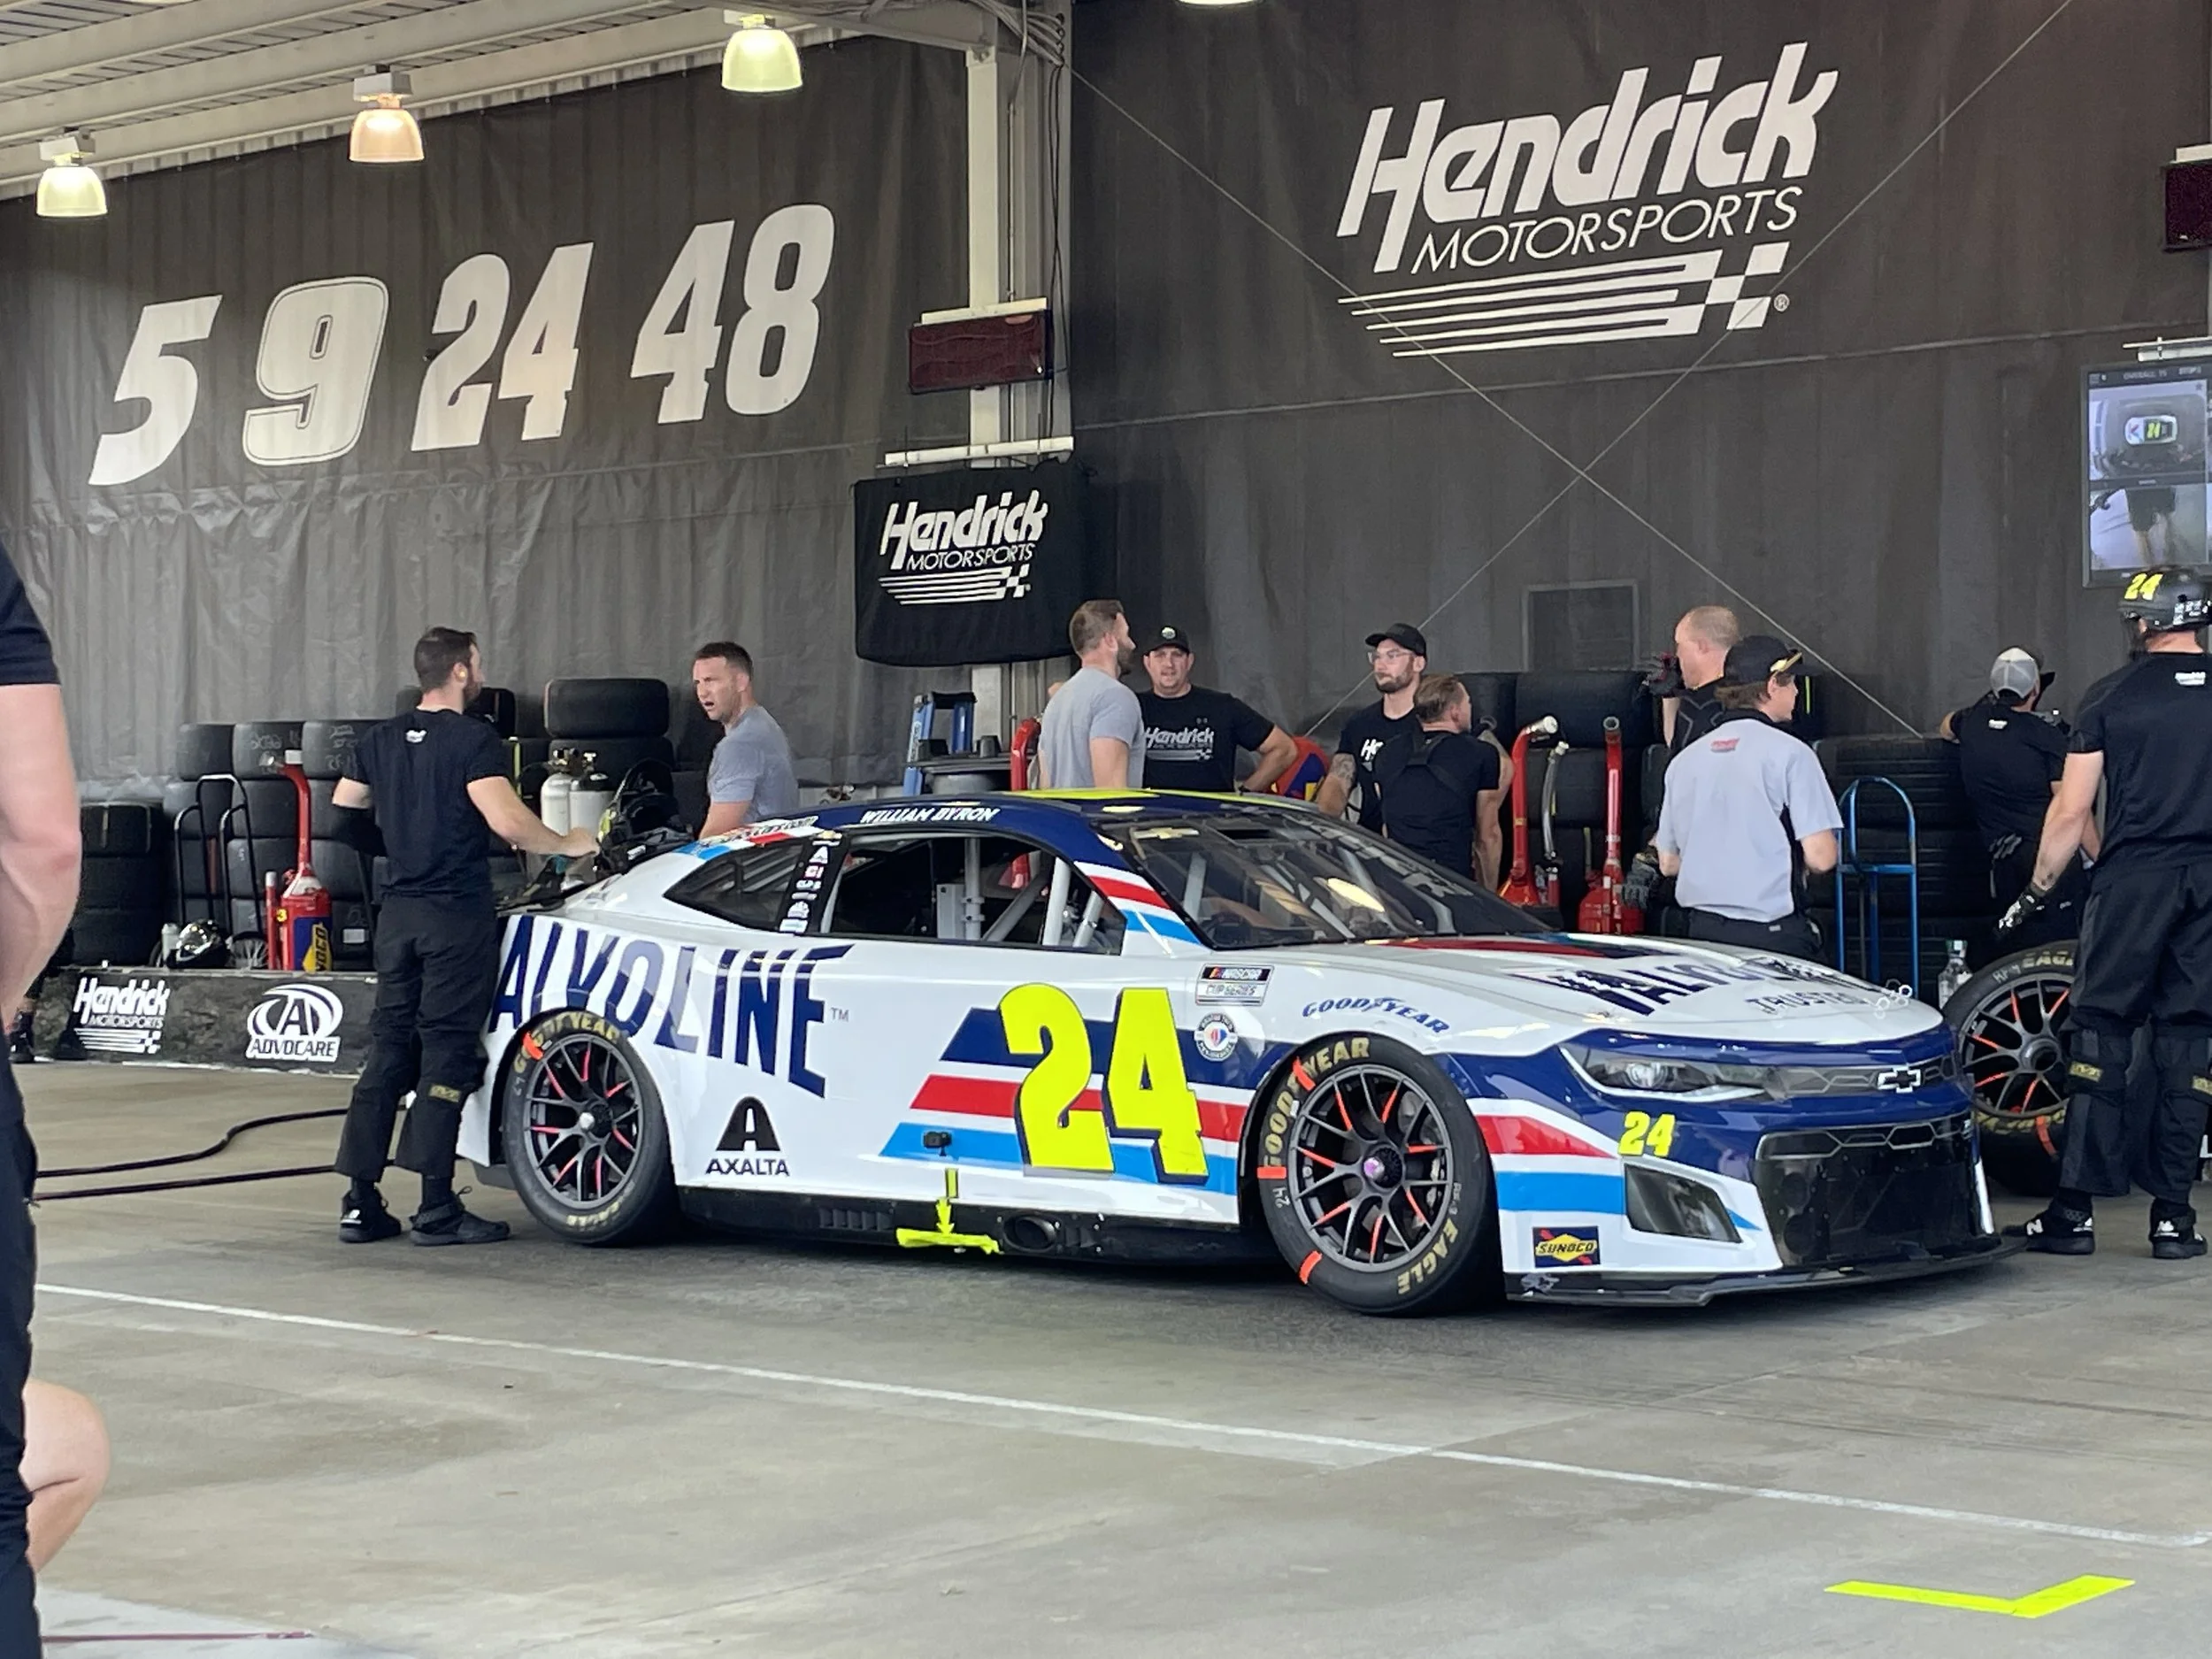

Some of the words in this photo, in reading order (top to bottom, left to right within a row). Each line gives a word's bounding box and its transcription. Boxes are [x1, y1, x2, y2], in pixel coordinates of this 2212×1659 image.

[1336, 42, 1839, 273] Hendrick
[1410, 186, 1802, 275] MOTORSPORTS
[89, 294, 223, 486] 5
[242, 275, 389, 465] 9
[411, 242, 594, 451] 24
[630, 204, 835, 425] 48
[879, 489, 1048, 571] Hendrick
[906, 543, 1035, 572] MOTORSPORTS
[2124, 573, 2163, 601] 24
[1146, 727, 1214, 748] Hendrick
[860, 807, 935, 824] WILLIAM
[931, 807, 1000, 821] BYRON
[73, 977, 171, 1025] Hendrick
[488, 914, 855, 1098] ALVOLINE
[1302, 996, 1451, 1033] GOODYEAR
[250, 1038, 335, 1057] ADVOCARE
[998, 982, 1209, 1184] 24
[1617, 1110, 1676, 1157] 24
[705, 1158, 790, 1177] AXALTA
[1272, 1186, 1291, 1209] 24
[1396, 1218, 1459, 1295] EAGLE
[1538, 1241, 1595, 1254] SUNOCO
